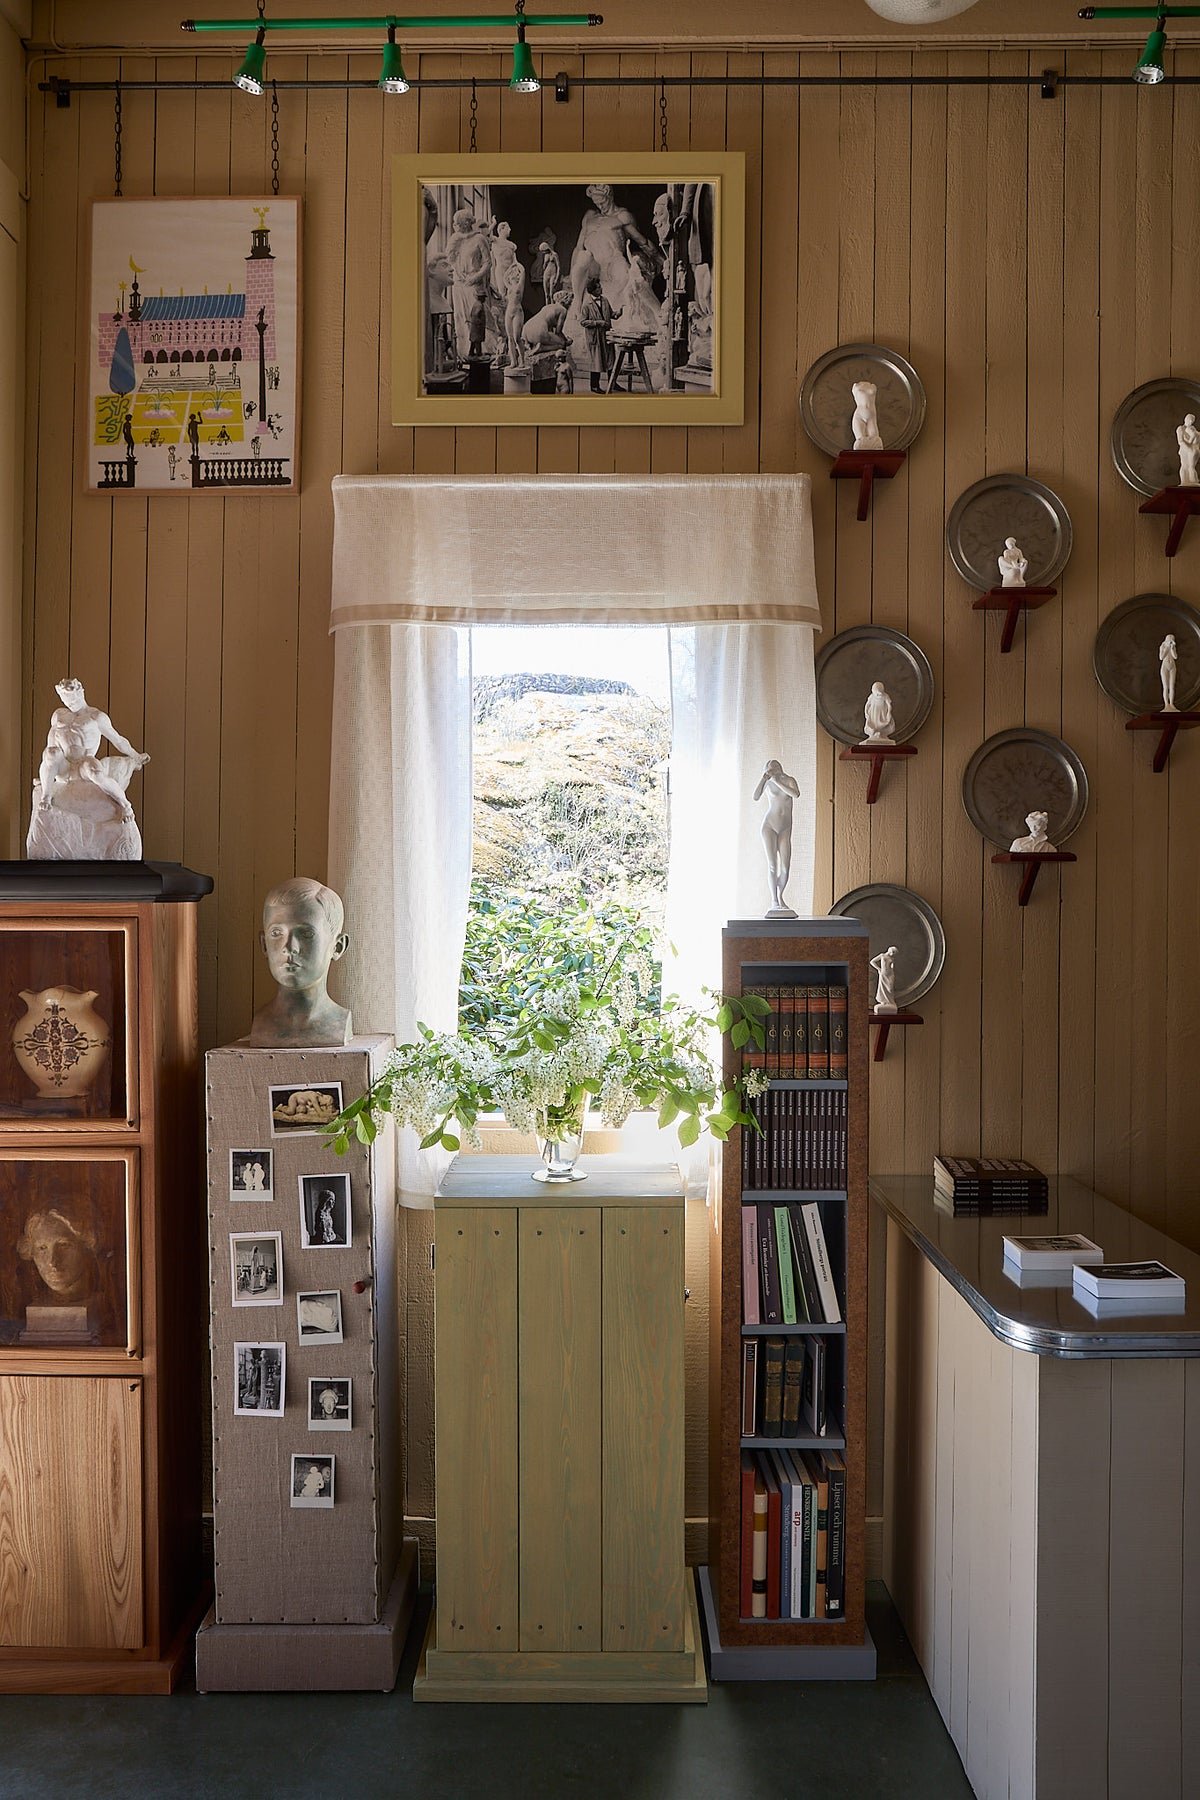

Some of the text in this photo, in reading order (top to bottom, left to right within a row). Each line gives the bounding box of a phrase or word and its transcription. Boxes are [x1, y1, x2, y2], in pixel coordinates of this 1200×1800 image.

[793, 1511, 801, 1526] arp
[803, 1511, 811, 1542] CORNELL
[831, 1483, 844, 1566] Ljuset och rummet
